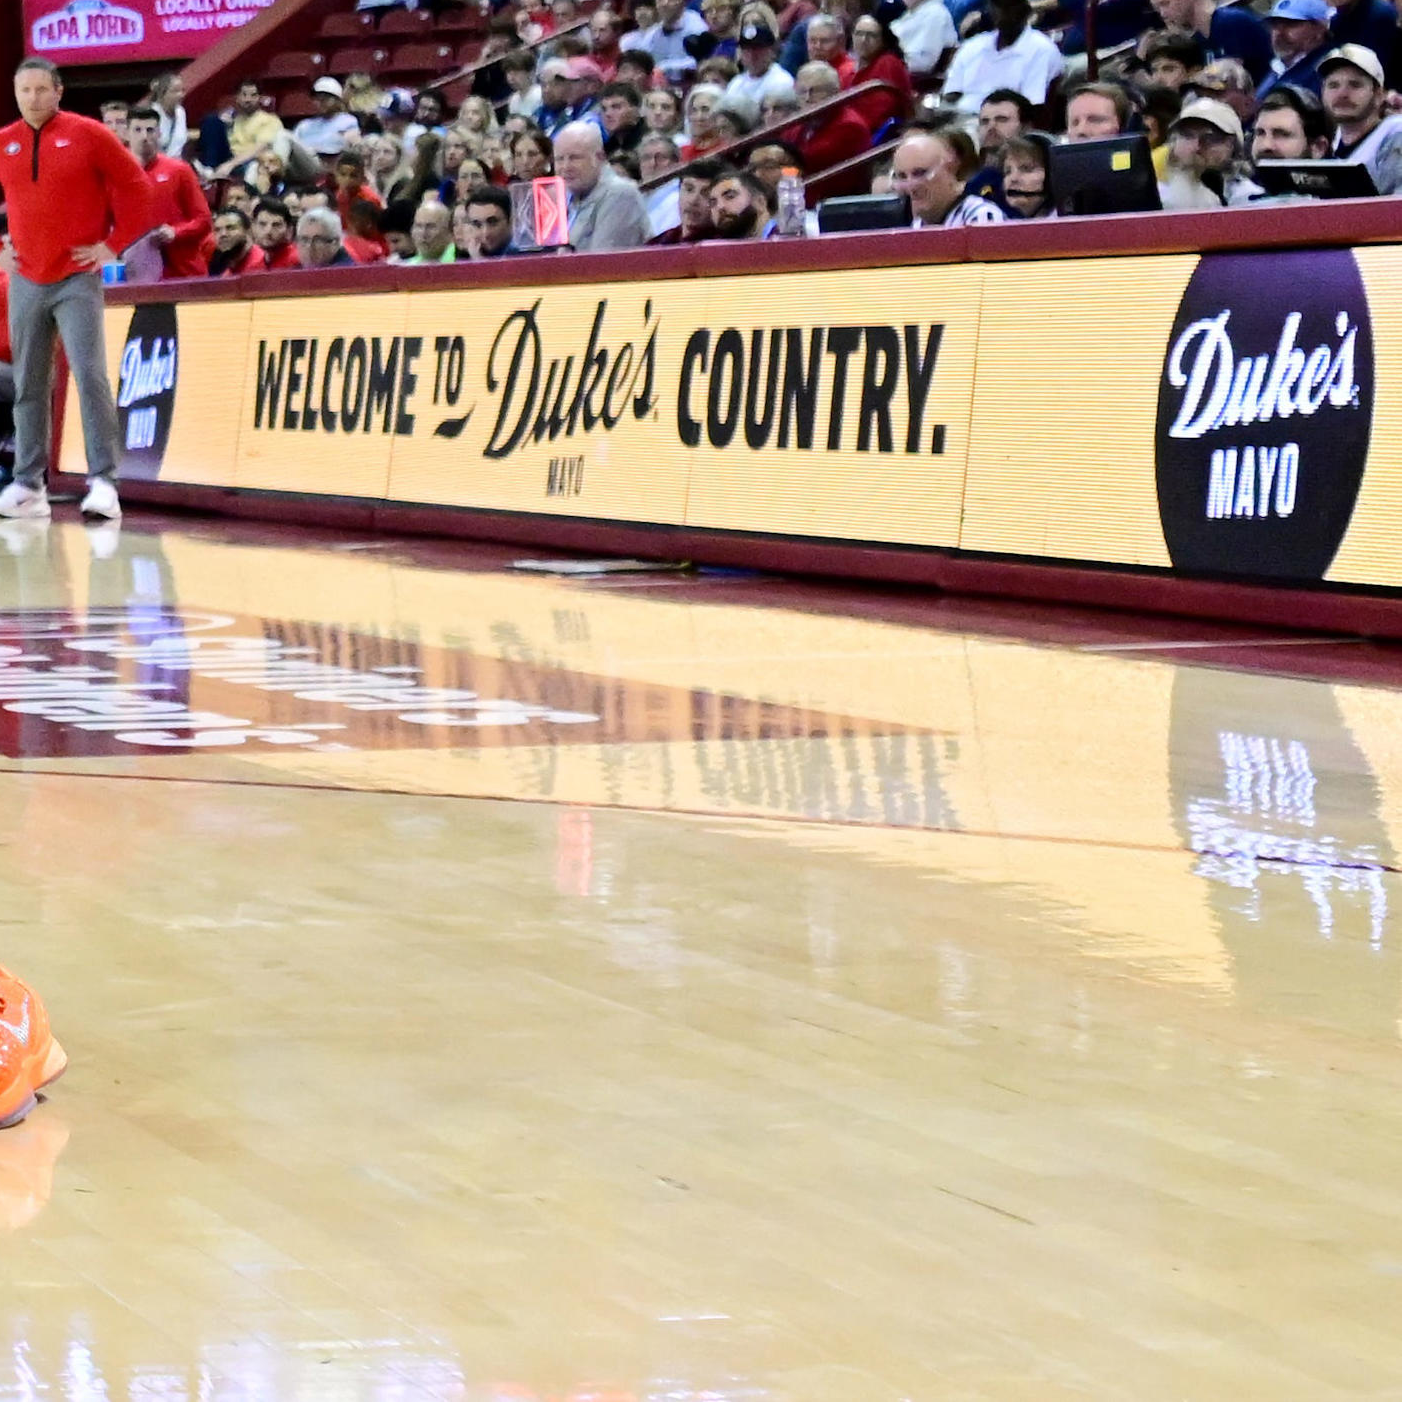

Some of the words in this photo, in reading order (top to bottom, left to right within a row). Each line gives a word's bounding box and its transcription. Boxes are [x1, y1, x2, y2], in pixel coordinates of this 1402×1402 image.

[37, 16, 80, 44] PAPA
[163, 15, 214, 33] LOCALLY
[119, 336, 176, 409] Duke's
[253, 336, 418, 435] WELCOME
[433, 336, 466, 407] TO
[481, 297, 660, 460] Duke's
[676, 323, 947, 455] COUNTRY.
[1168, 309, 1360, 439] Duke's
[546, 455, 585, 499] MAYO
[1206, 442, 1300, 520] MAYO
[63, 636, 602, 727] Shriners
